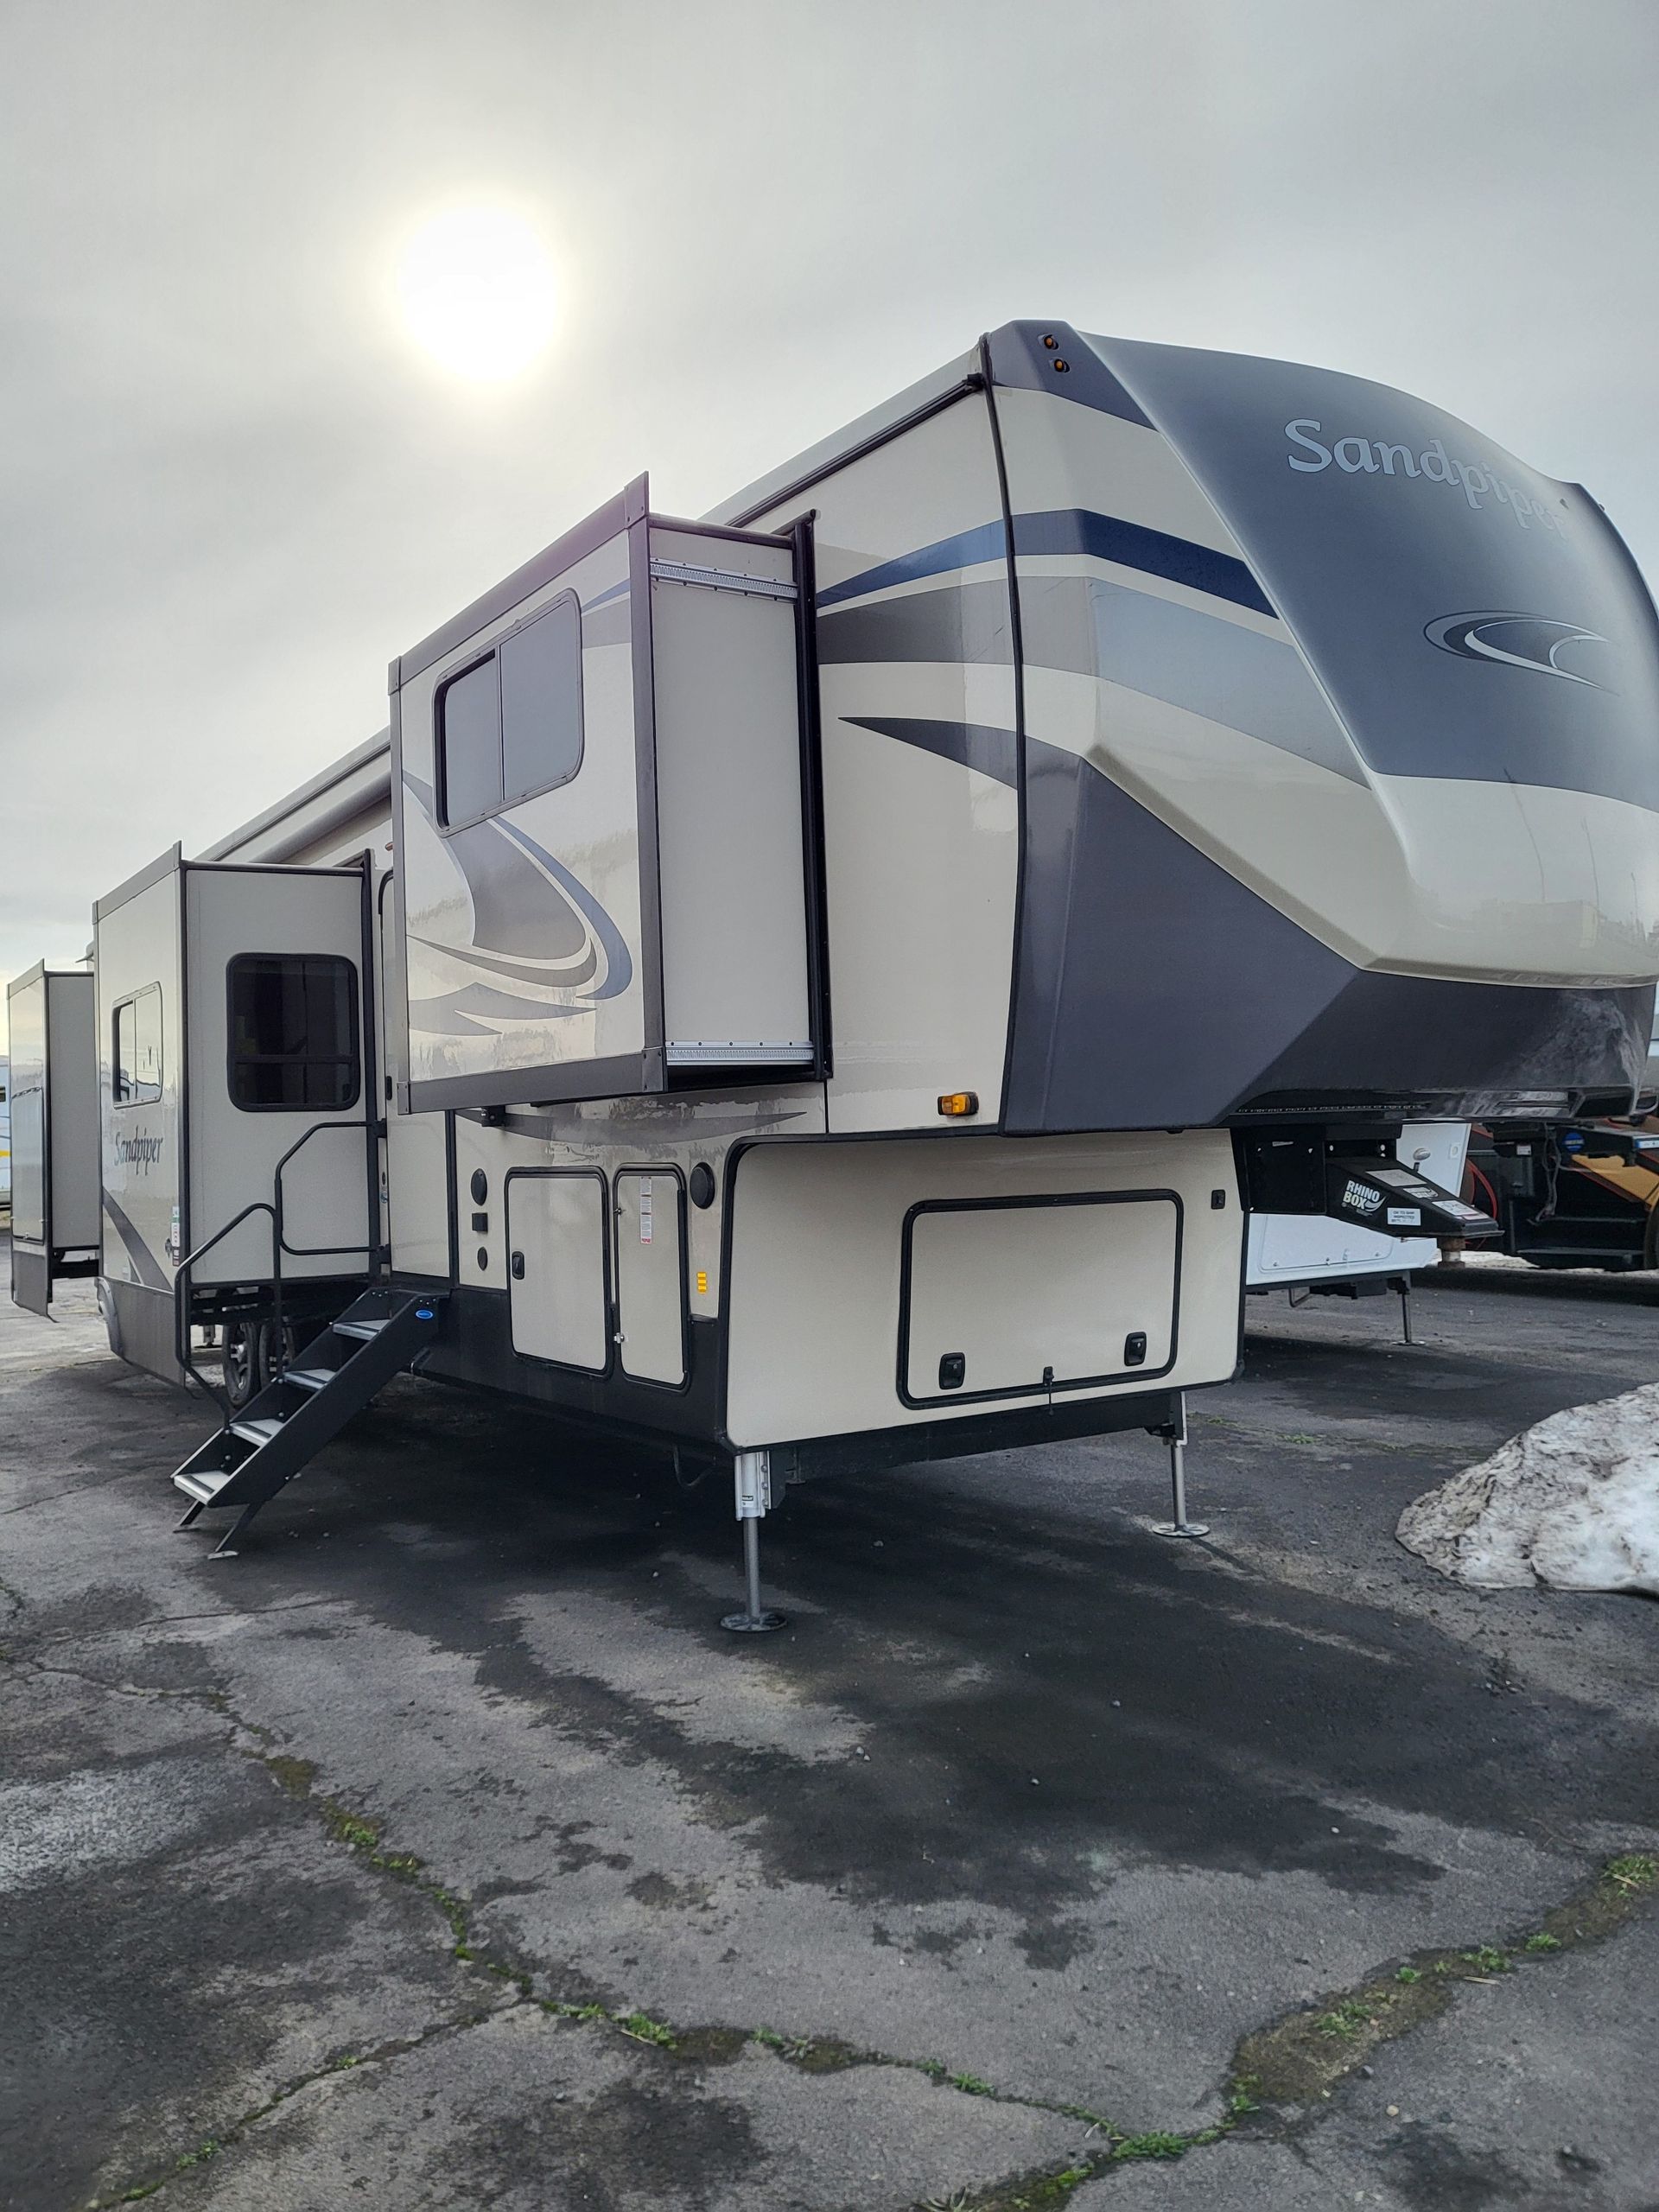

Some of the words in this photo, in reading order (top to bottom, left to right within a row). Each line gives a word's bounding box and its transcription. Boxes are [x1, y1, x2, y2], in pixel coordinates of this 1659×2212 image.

[1284, 418, 1567, 542] Sandpiper
[114, 1125, 163, 1176] Sandpiper
[1343, 1191, 1367, 1210] BOX
[1346, 1179, 1380, 1203] RHINO
